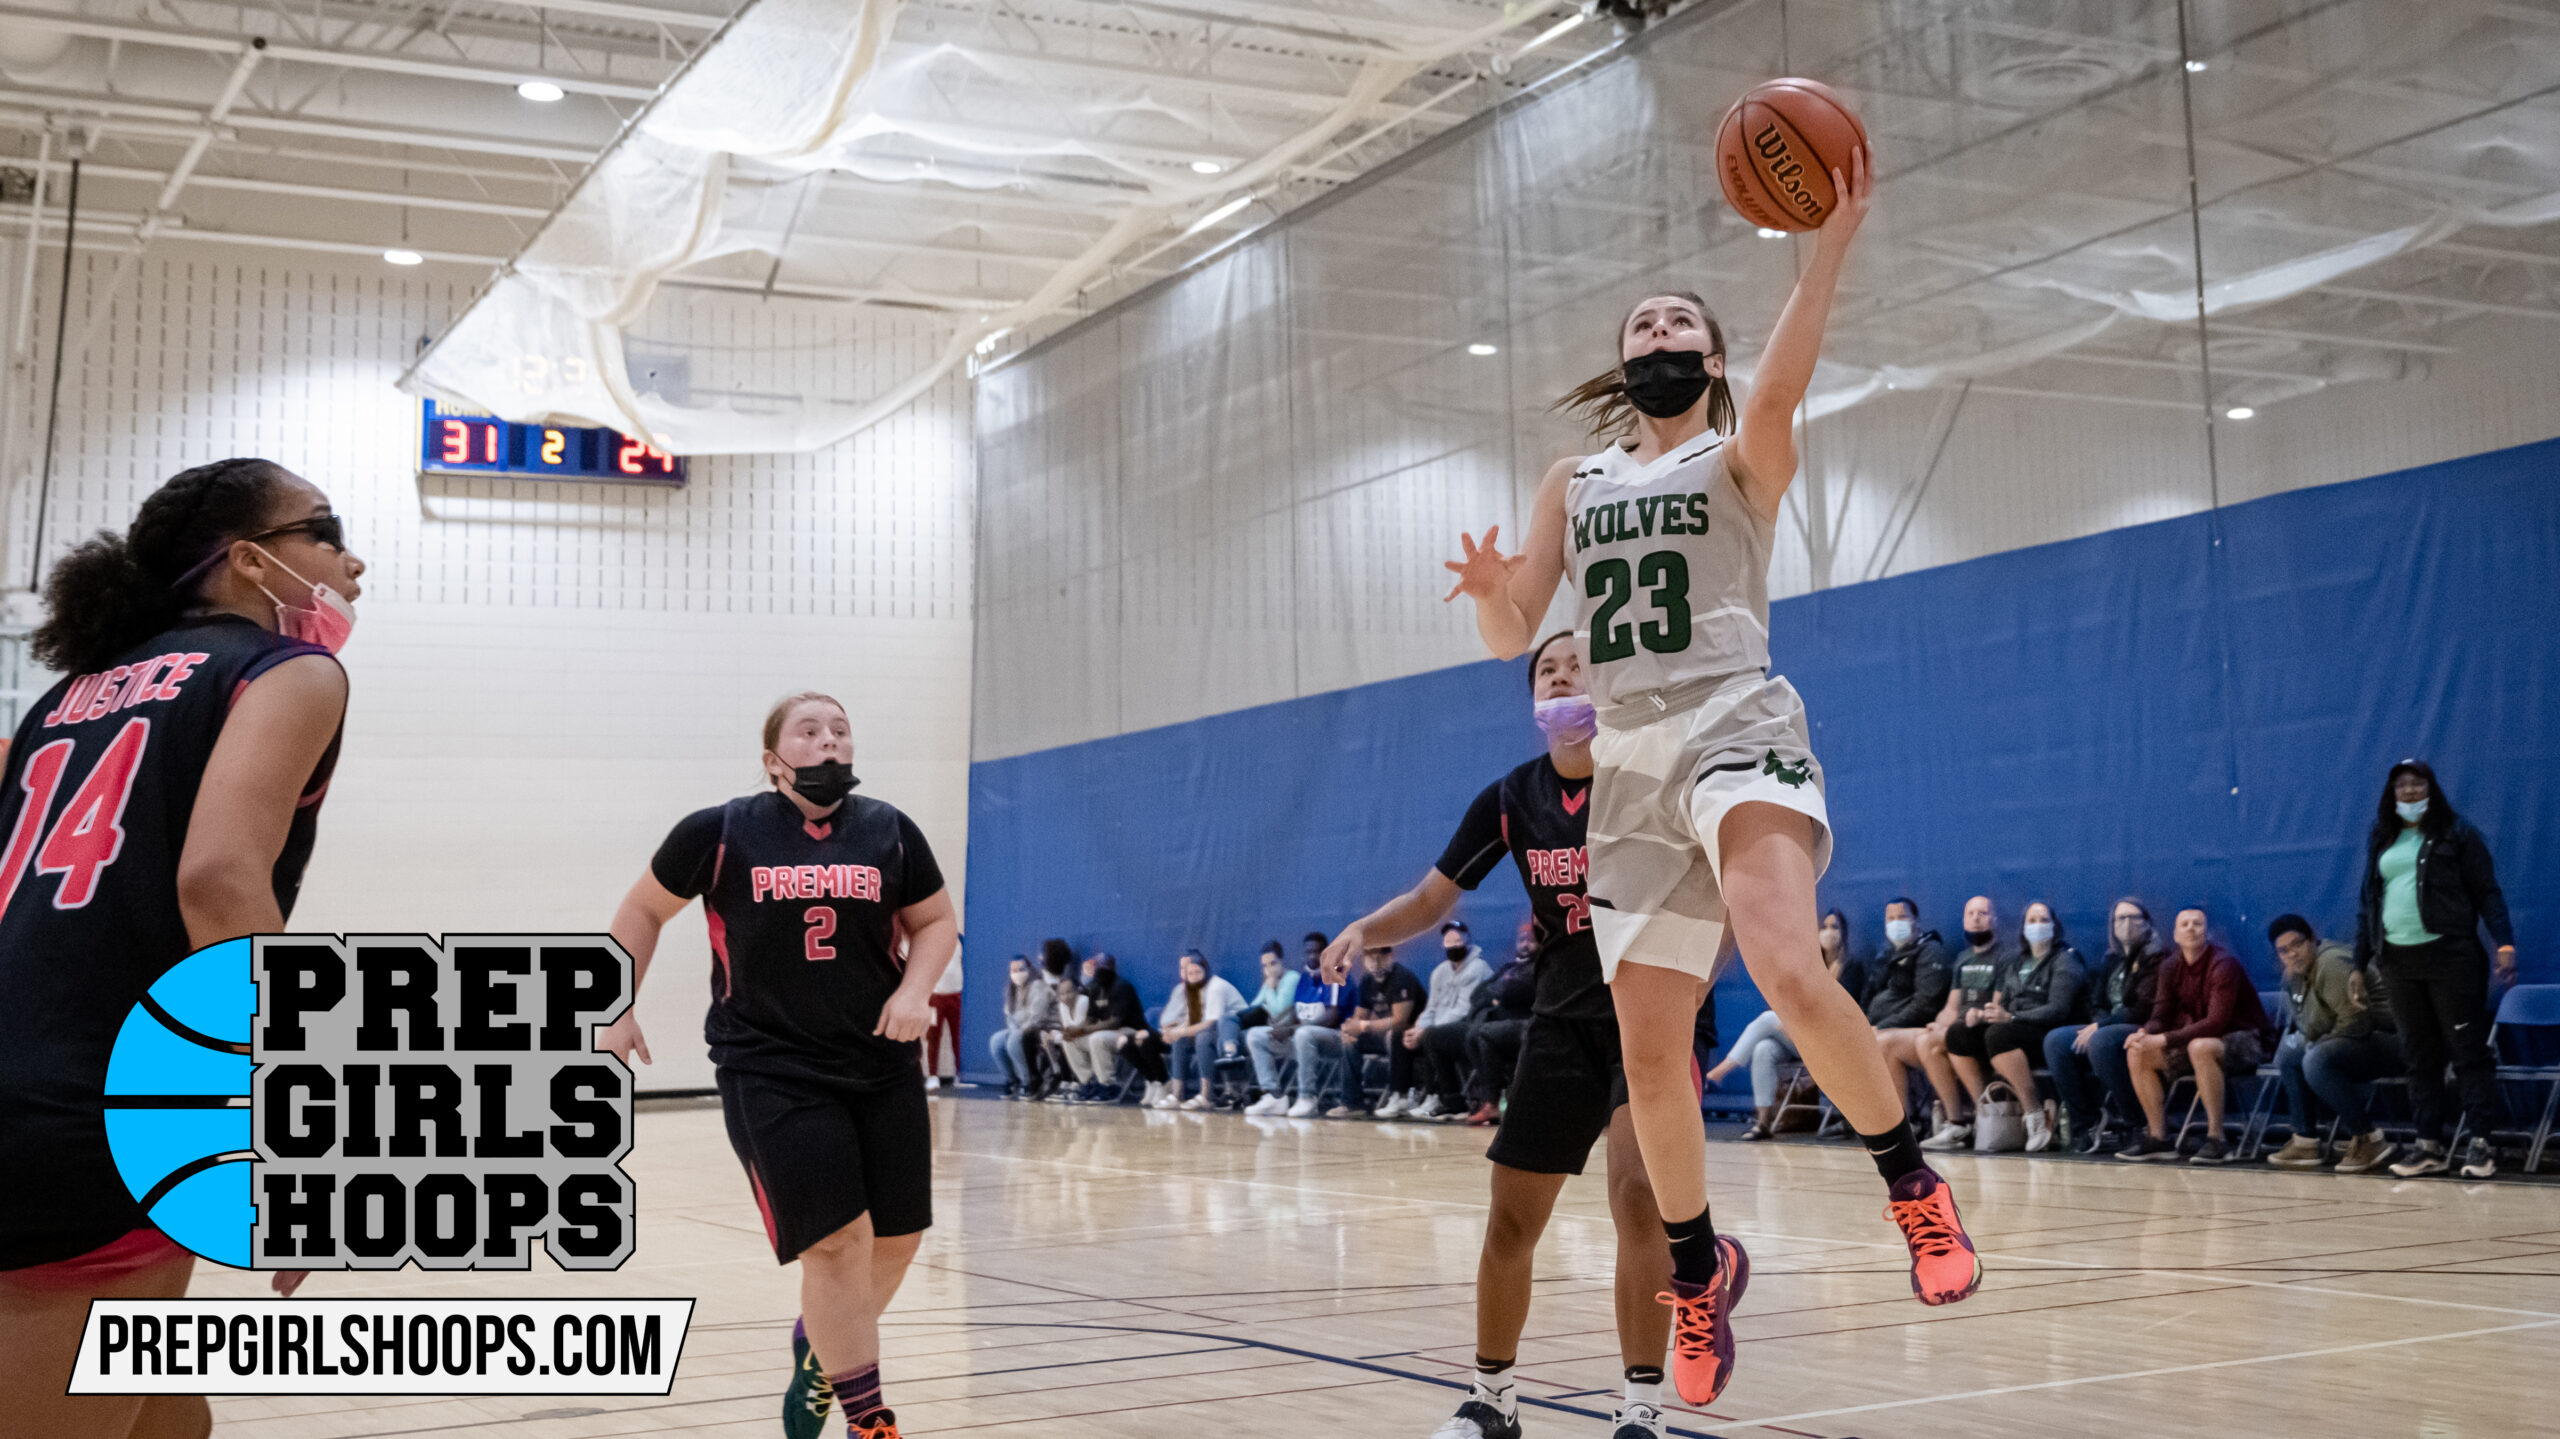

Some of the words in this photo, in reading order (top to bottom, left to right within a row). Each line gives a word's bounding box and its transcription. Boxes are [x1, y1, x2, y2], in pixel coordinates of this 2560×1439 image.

[1754, 123, 1824, 219] Wilson
[443, 420, 497, 463] 31
[541, 430, 565, 464] 2
[1572, 493, 1709, 553] WOLVES
[1585, 550, 1692, 665] 23
[44, 653, 210, 727] JUSTICE
[0, 717, 150, 922] 14
[751, 865, 881, 902] PREMIER
[1527, 846, 1590, 886] PREM
[804, 906, 837, 961] 2
[1557, 893, 1592, 935] 2
